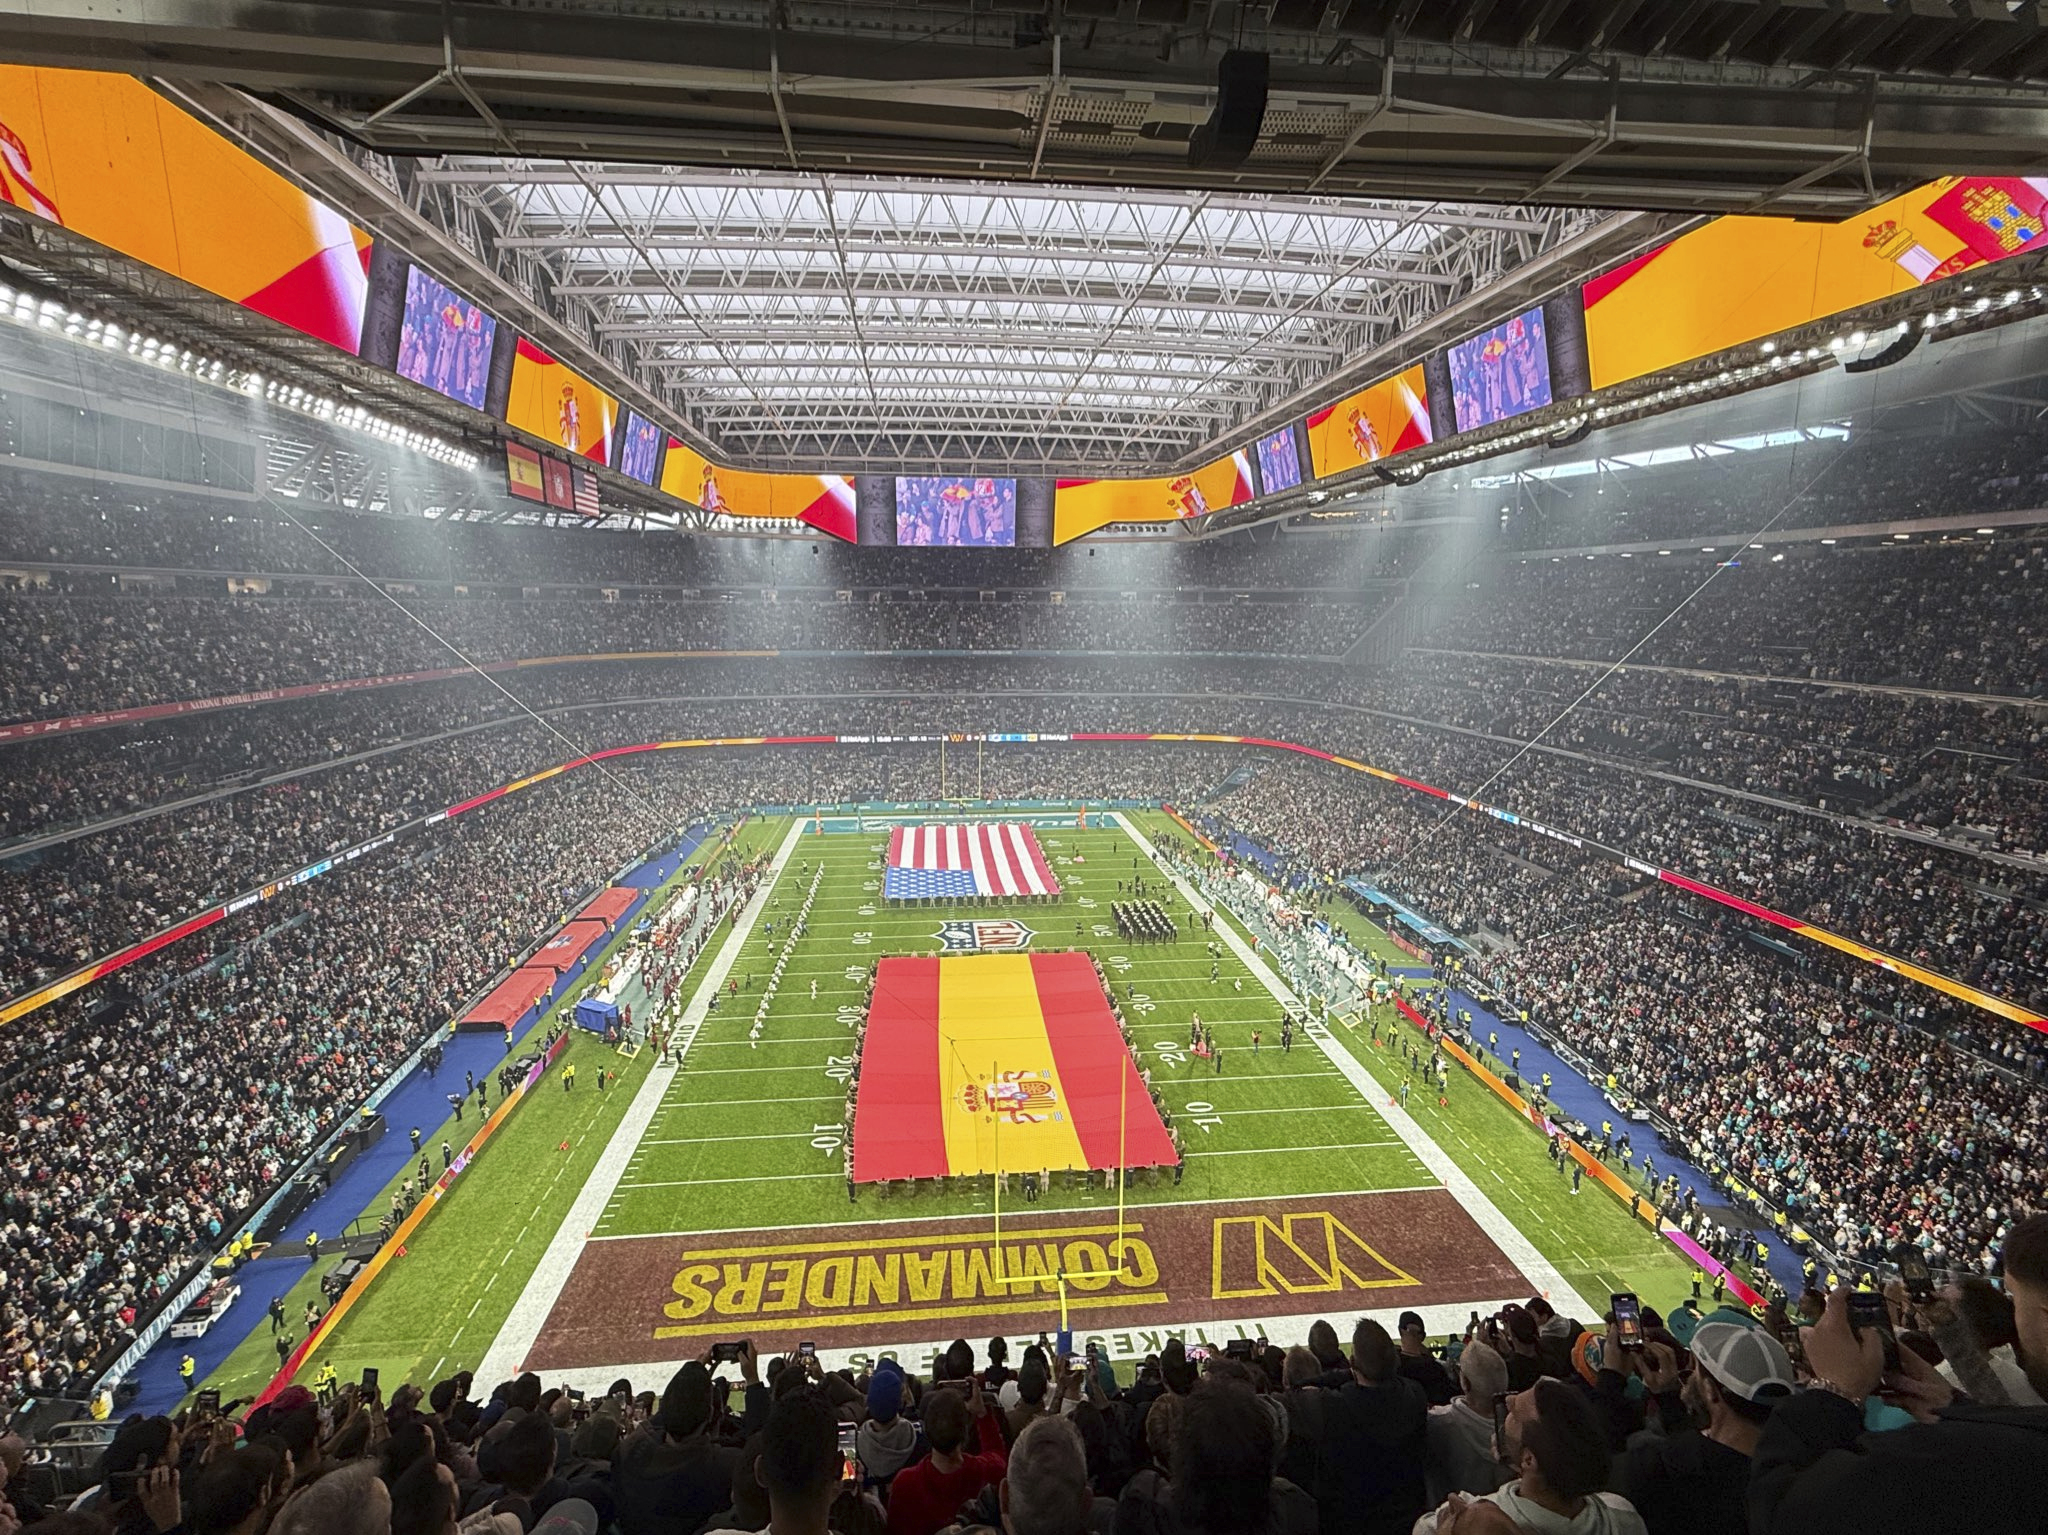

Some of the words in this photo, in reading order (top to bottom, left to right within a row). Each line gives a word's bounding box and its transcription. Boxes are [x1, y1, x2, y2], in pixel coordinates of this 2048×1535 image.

[190, 699, 221, 710] NATIONAL
[222, 694, 252, 706] FOOTBALL
[253, 691, 274, 701] LEAGUE
[976, 922, 1022, 948] NFL
[844, 964, 867, 980] 40
[836, 1004, 861, 1023] 30
[1153, 1041, 1187, 1063] 20
[825, 1055, 853, 1079] 20
[1185, 1101, 1224, 1127] 10
[810, 1122, 844, 1150] 10
[663, 1234, 1161, 1321] COMMANDERS
[111, 1325, 159, 1379] MIAMI
[157, 1265, 213, 1335] DOLPHINS
